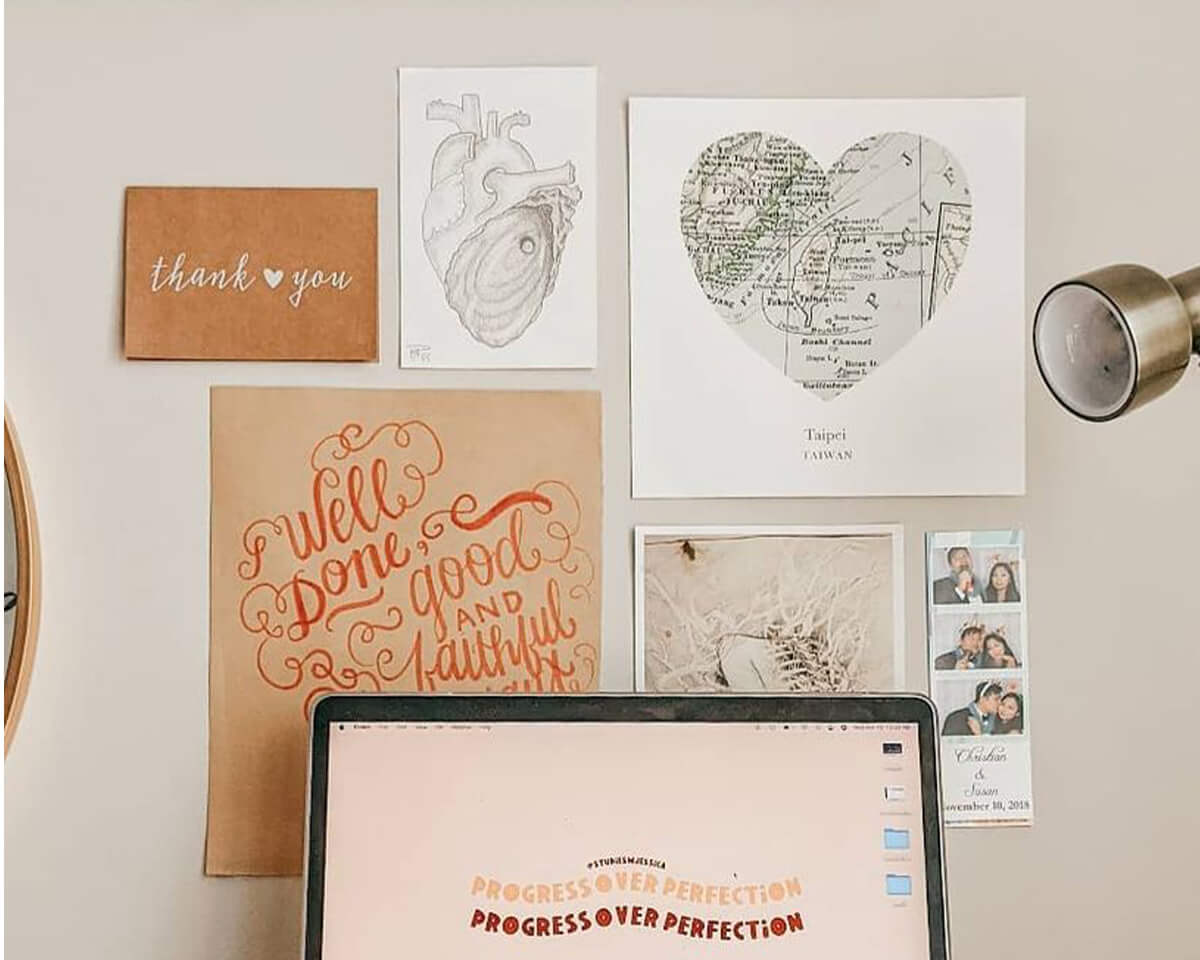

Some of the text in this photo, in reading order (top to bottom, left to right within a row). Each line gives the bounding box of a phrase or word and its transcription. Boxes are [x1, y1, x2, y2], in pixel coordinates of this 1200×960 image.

[150, 252, 353, 308] thank you
[803, 427, 847, 445] Taipei
[802, 449, 853, 461] TAIWAN
[409, 507, 542, 644] good
[456, 590, 524, 632] AND
[404, 576, 578, 692] faithful
[954, 745, 1008, 764] Christian
[964, 781, 999, 797] Susan
[944, 801, 990, 811] ovember
[471, 874, 591, 905] PROGRESS
[594, 870, 658, 895] OVER
[470, 908, 592, 938] PROGRESS
[595, 905, 659, 929] OVER
